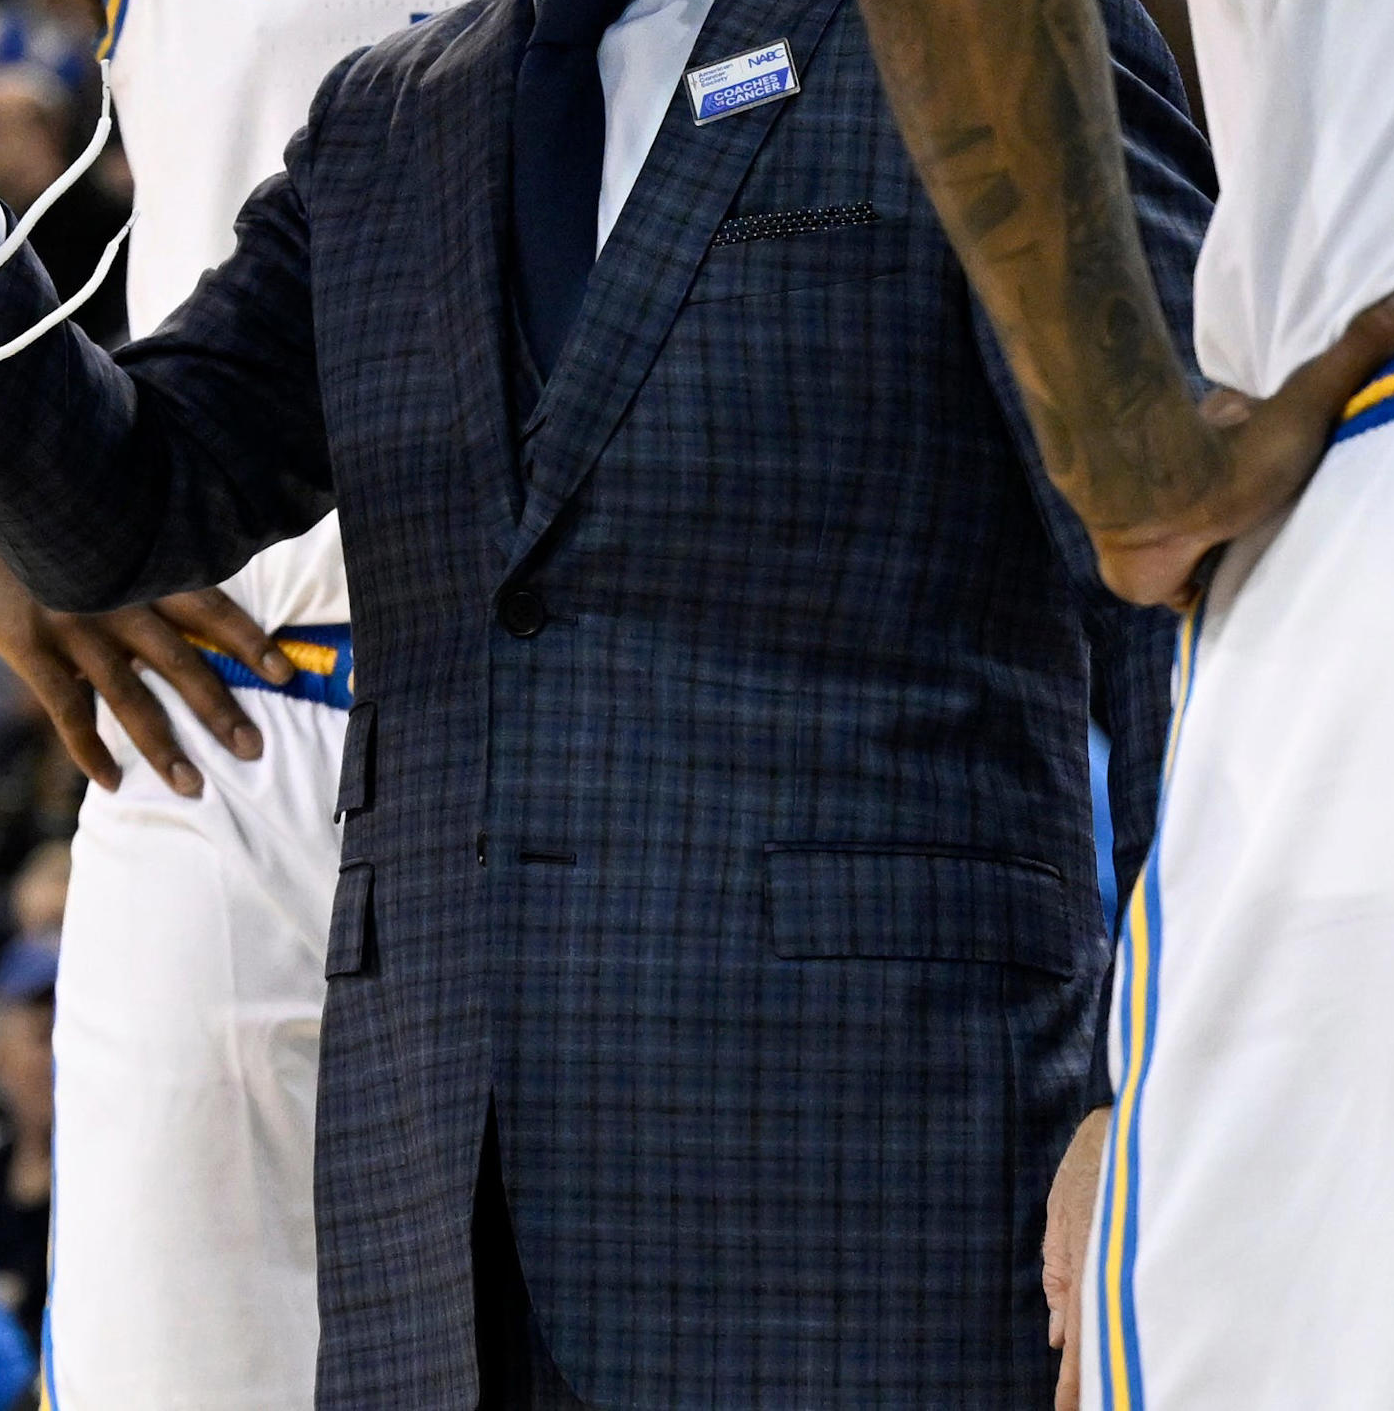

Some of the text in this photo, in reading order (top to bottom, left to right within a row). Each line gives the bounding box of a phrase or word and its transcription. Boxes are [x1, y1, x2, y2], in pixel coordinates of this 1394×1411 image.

[747, 48, 785, 68] NABC
[713, 73, 779, 101] COACHES
[725, 82, 782, 106] CANCER
